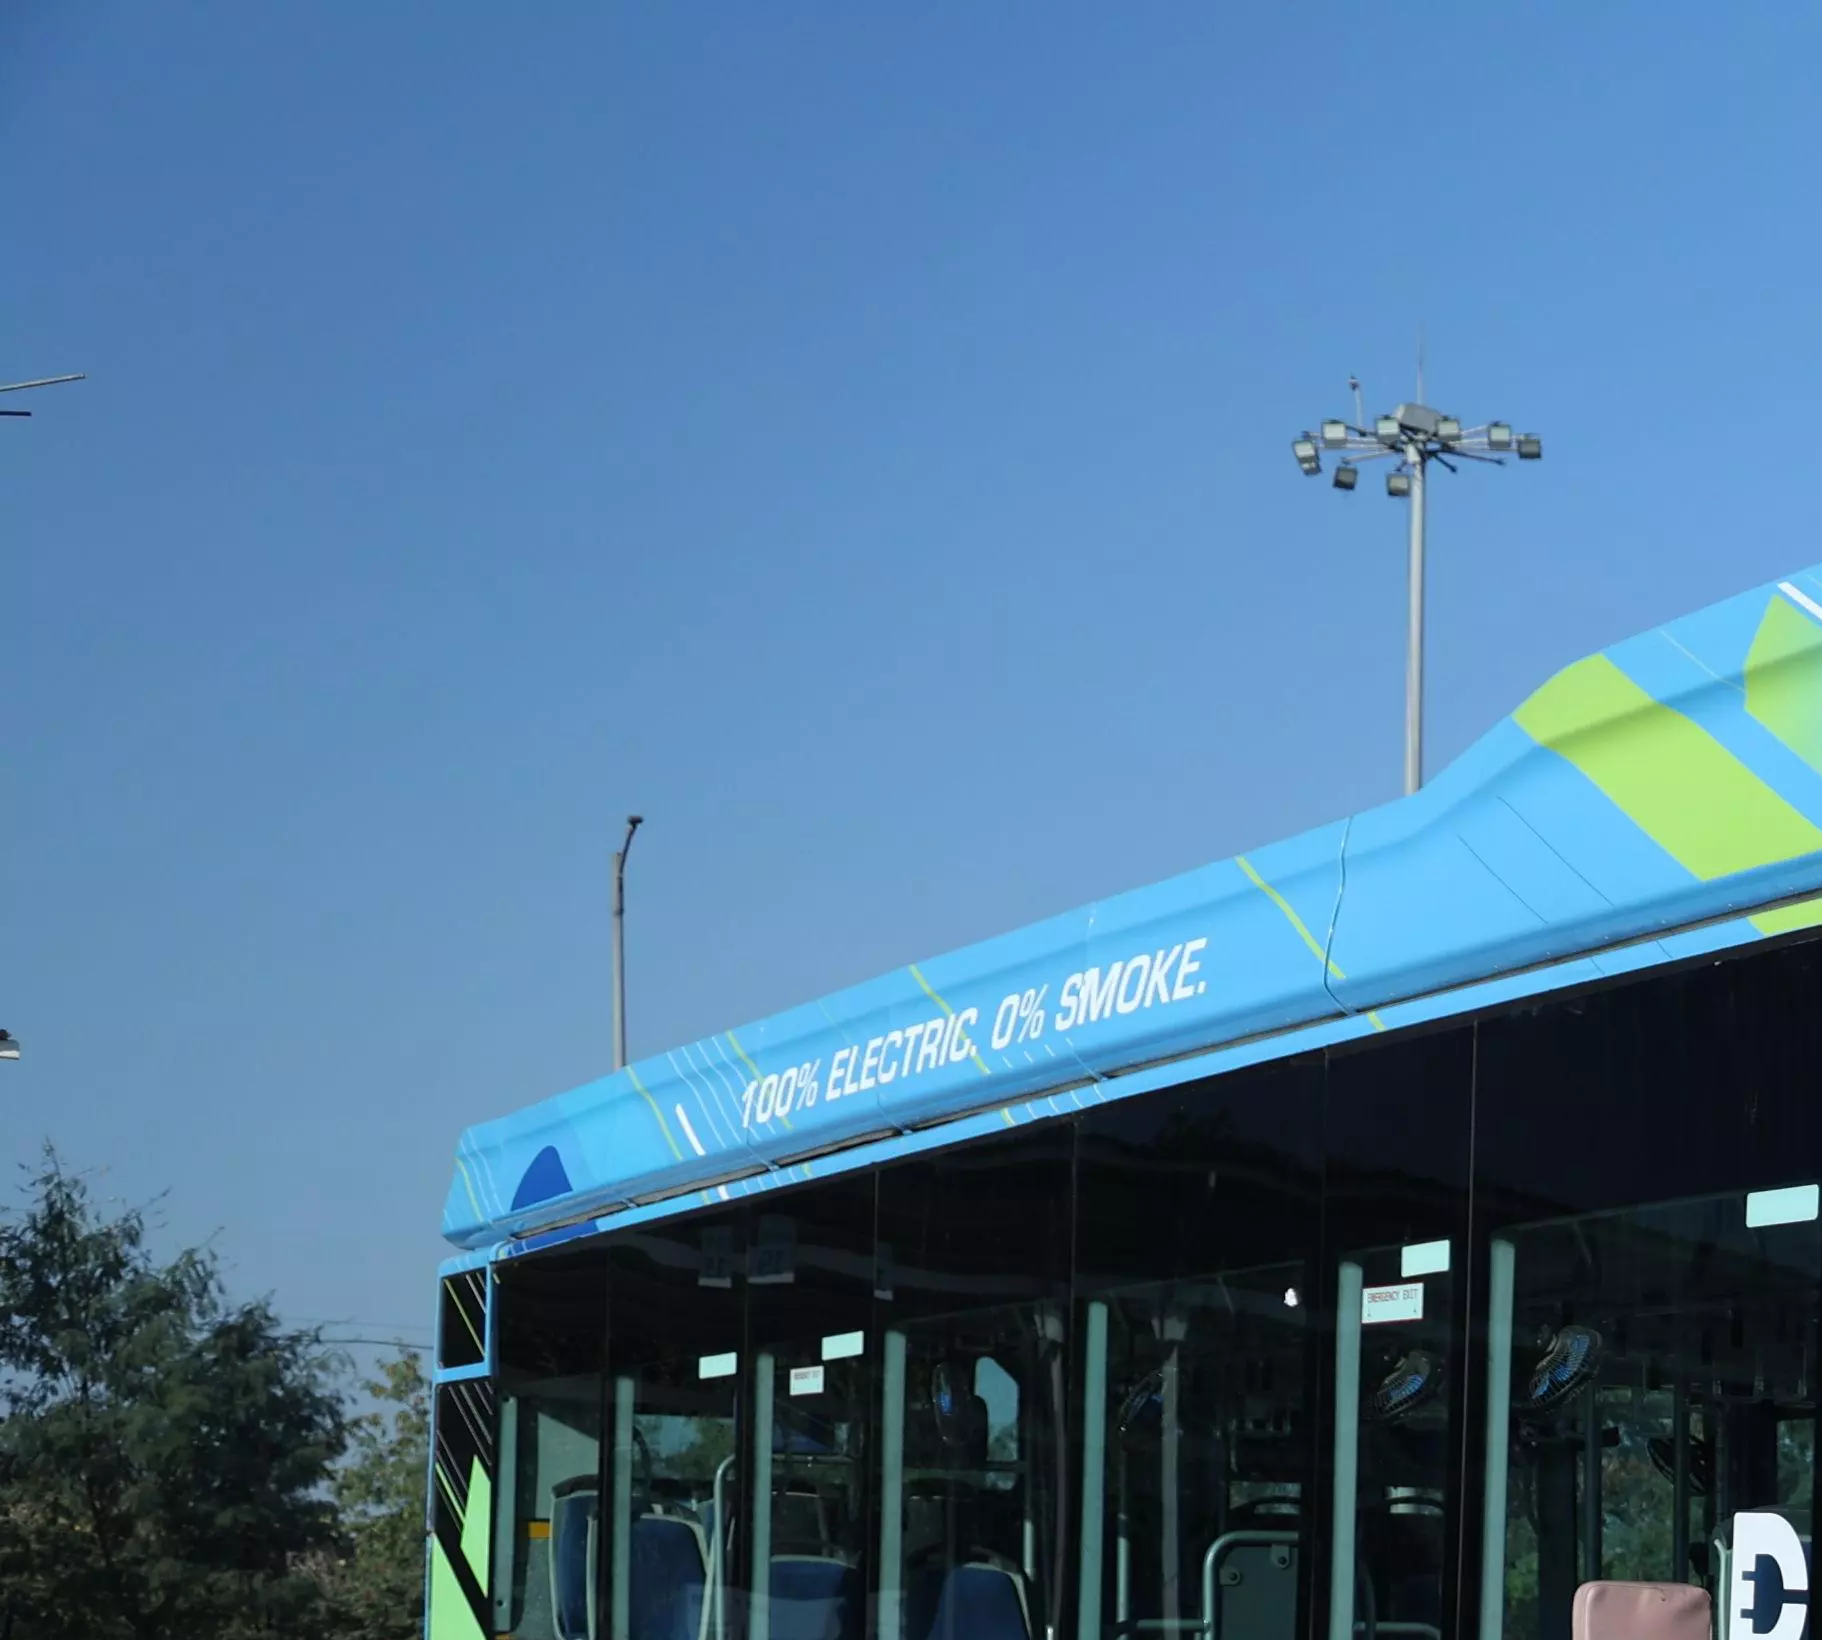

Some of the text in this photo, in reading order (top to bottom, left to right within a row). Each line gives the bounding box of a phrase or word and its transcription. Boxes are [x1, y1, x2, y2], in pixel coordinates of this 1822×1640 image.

[742, 938, 1208, 1129] 100% ELECTRIC. 0% SMOKE.
